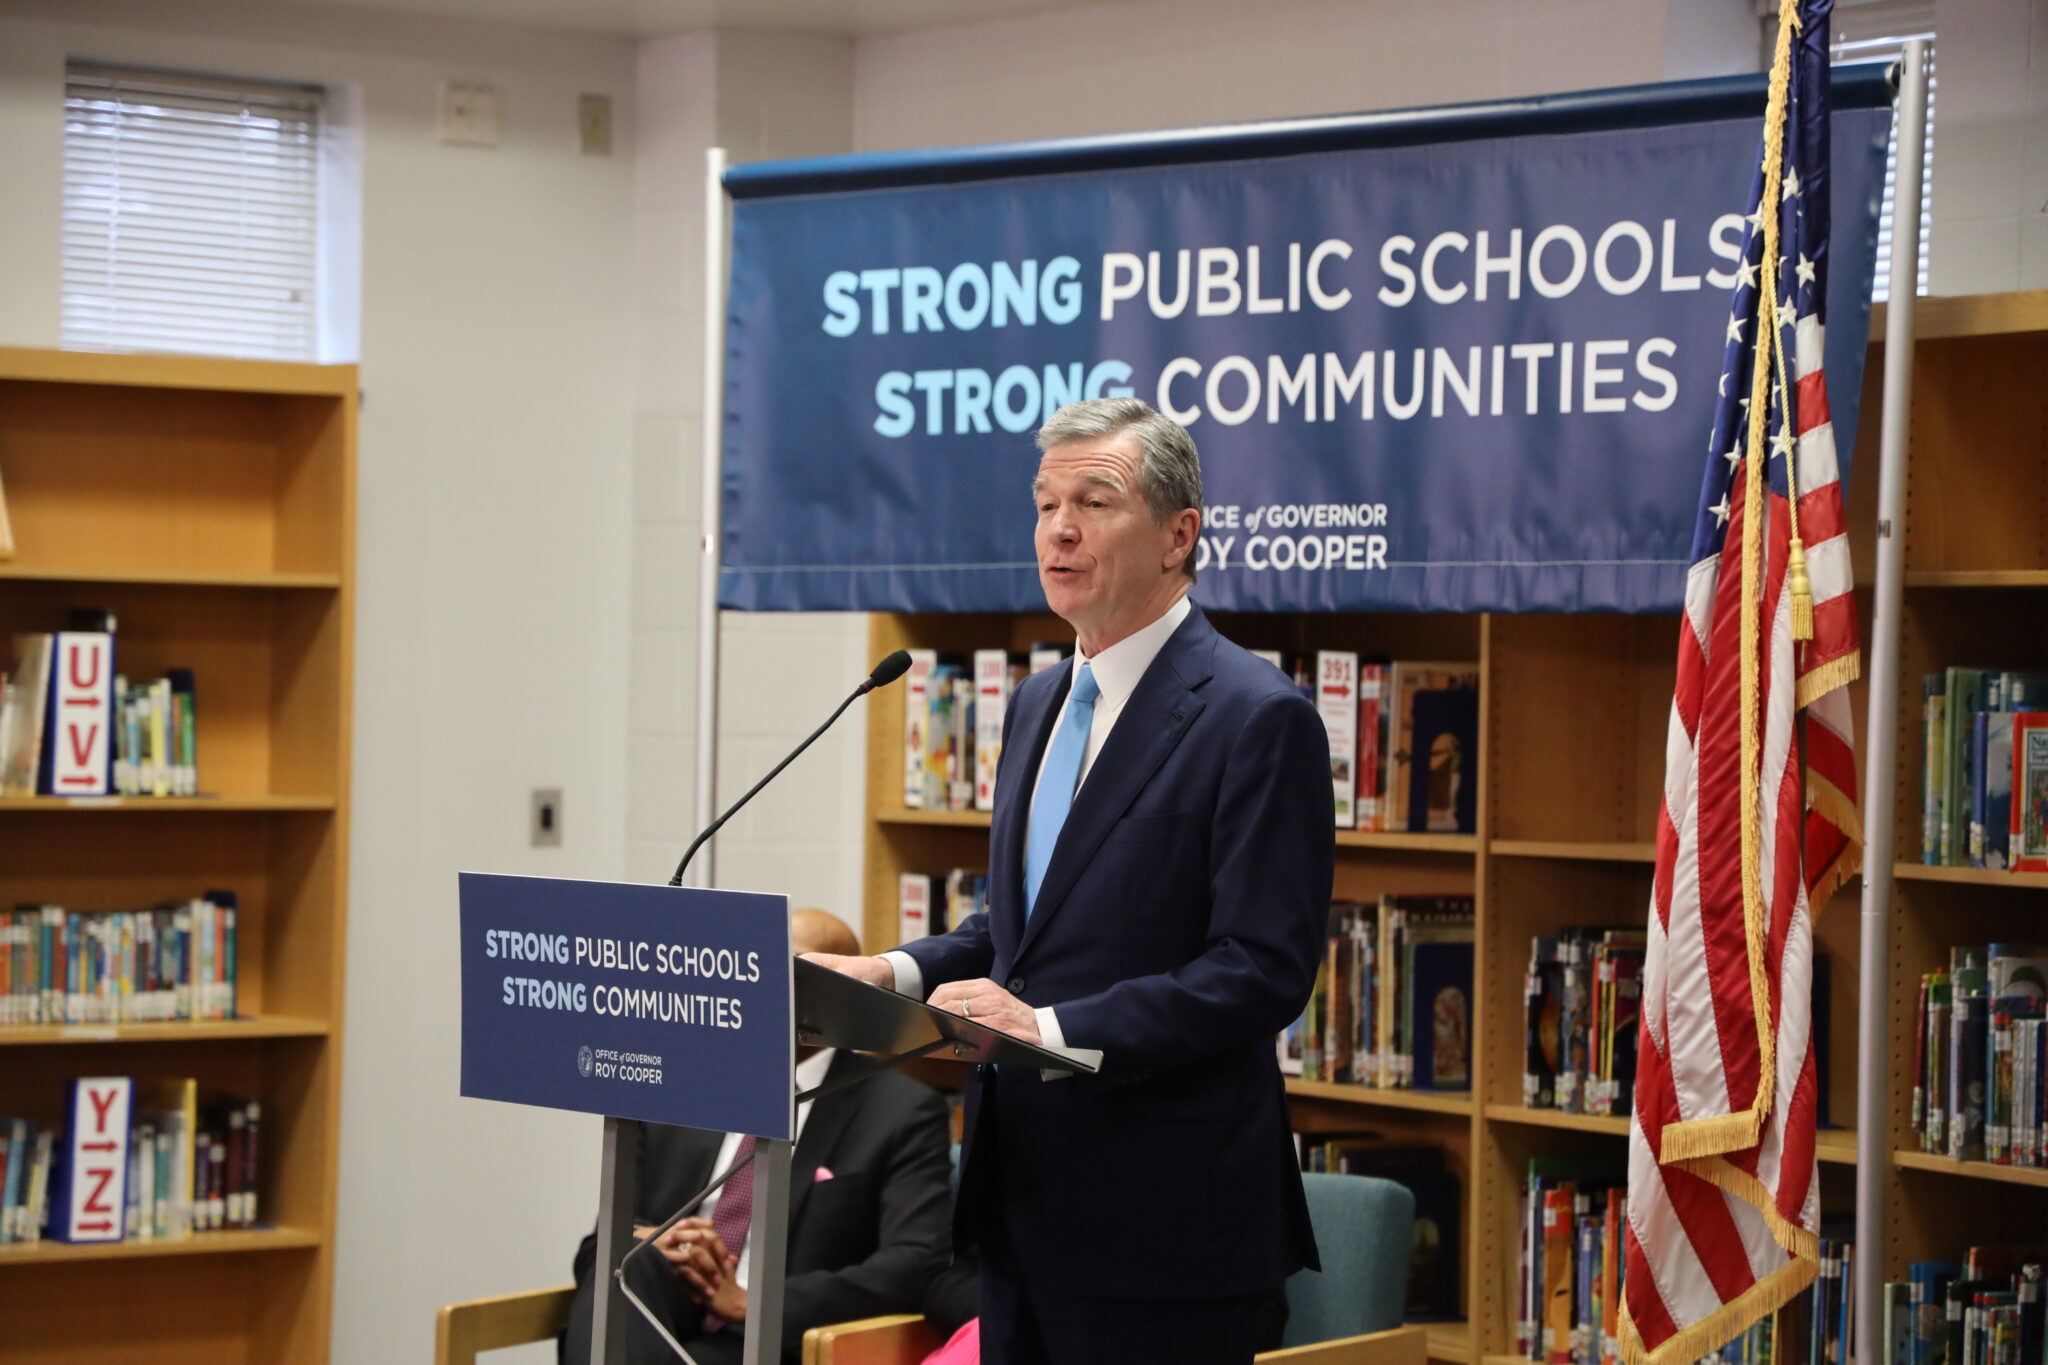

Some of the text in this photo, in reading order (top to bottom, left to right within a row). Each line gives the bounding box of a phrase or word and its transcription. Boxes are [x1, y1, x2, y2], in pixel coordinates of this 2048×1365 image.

[822, 213, 1747, 338] STRONG PUBLIC SCHOOLS
[874, 337, 1678, 438] STRONG COMMUNITIES
[1203, 503, 1388, 534] ICE of GOVERNOR
[1195, 534, 1388, 571] OY COOPER
[70, 645, 99, 688] U
[1323, 658, 1351, 680] 391
[69, 724, 97, 767] V
[486, 929, 760, 982] STRONG PUBLIC SCHOOLS
[503, 976, 742, 1029] STRONG COMMUNITIES
[595, 1048, 618, 1061] OFFICE
[619, 1053, 625, 1064] of
[625, 1052, 662, 1066] GOVERNOR
[595, 1062, 662, 1085] ROY COOPER
[88, 1089, 117, 1133] Y
[83, 1169, 114, 1213] Z
